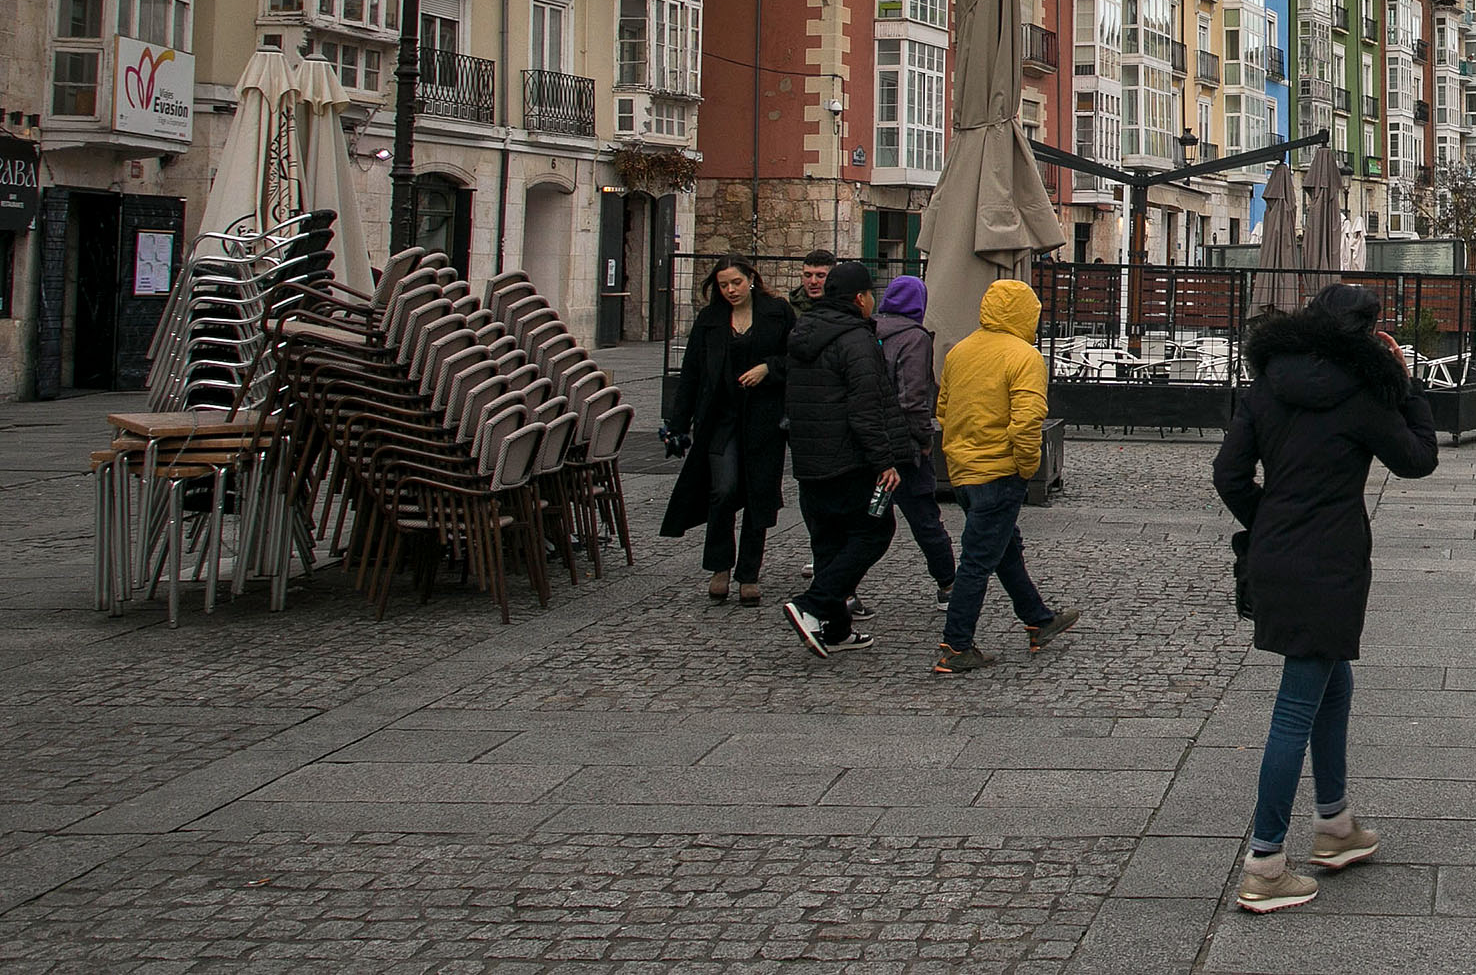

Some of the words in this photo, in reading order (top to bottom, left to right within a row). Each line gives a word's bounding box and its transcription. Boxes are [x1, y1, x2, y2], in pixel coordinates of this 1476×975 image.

[159, 88, 174, 101] Viajes
[154, 97, 188, 118] Evasión
[552, 158, 556, 169] 6
